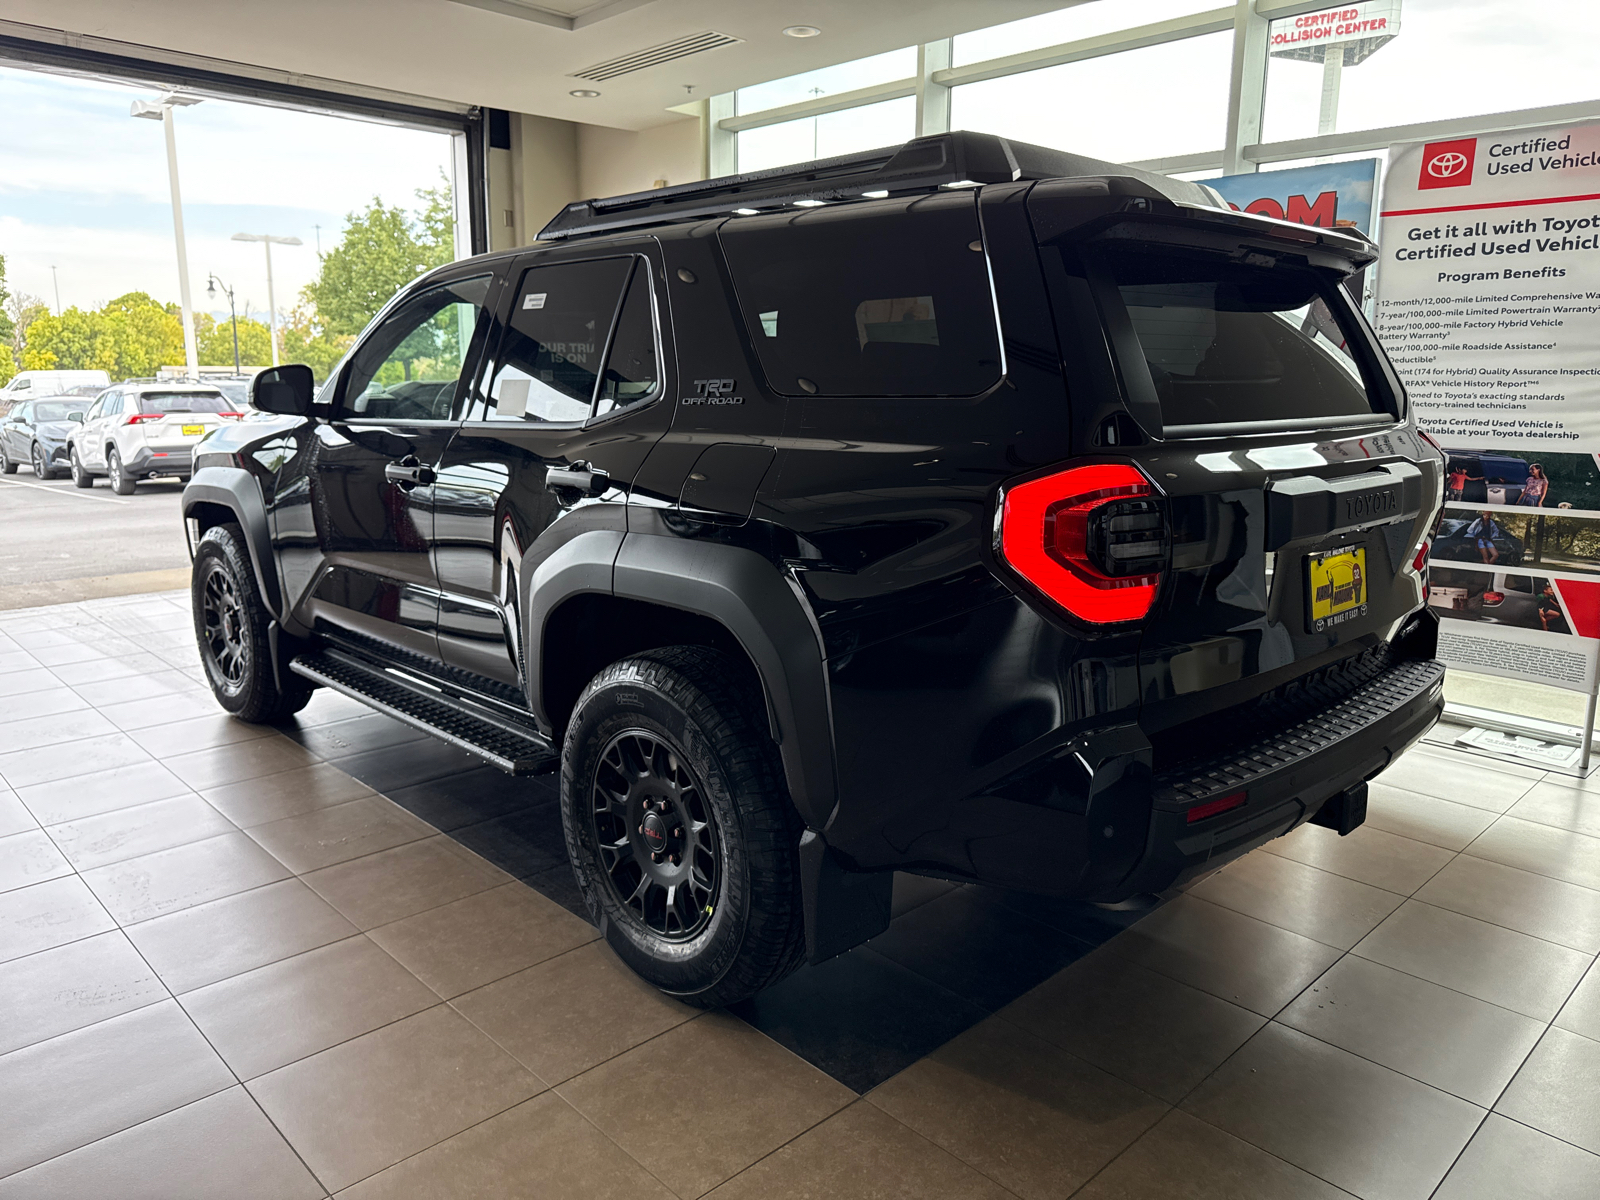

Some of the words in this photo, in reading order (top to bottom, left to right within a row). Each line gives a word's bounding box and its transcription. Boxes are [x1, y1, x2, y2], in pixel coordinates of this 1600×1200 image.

[1295, 9, 1358, 28] CERTIFIED
[1336, 18, 1386, 35] CENTER
[1488, 134, 1571, 158] Certified
[1487, 158, 1534, 176] Used
[1408, 227, 1441, 241] Get
[1446, 225, 1459, 238] it
[1463, 222, 1487, 237] all
[1492, 218, 1537, 235] with
[1542, 215, 1600, 234] Toyot
[1395, 242, 1476, 261] Certified
[1482, 239, 1531, 255] Used
[1536, 234, 1599, 252] Vehicl
[1438, 271, 1499, 284] Program
[1503, 266, 1566, 279] Benefits
[1381, 296, 1473, 307] 12-month/12,000-mile
[1476, 294, 1508, 302] Limited
[1510, 292, 1583, 302] Comprehensive
[1380, 309, 1464, 320] 7-year/100,000-mile
[1501, 306, 1550, 314] Powertrain
[1380, 321, 1462, 332] 8-year/100,000-mile
[1464, 321, 1496, 329] Factory
[1498, 320, 1528, 328] Hybrid
[1386, 344, 1460, 352] year/100,000-mile
[567, 353, 587, 363] ON
[1445, 368, 1477, 376] Hybrid)
[1479, 368, 1510, 376] Quality
[694, 379, 734, 396] TRD
[1463, 380, 1495, 388] History
[708, 397, 743, 405] ROAD
[1479, 393, 1517, 401] exacting
[1449, 418, 1490, 426] Certified
[1492, 430, 1524, 438] Toyota
[1526, 430, 1580, 440] dealership
[1346, 490, 1396, 520] TOYOTA
[1327, 617, 1333, 627] WE
[1334, 613, 1344, 625] MAKE
